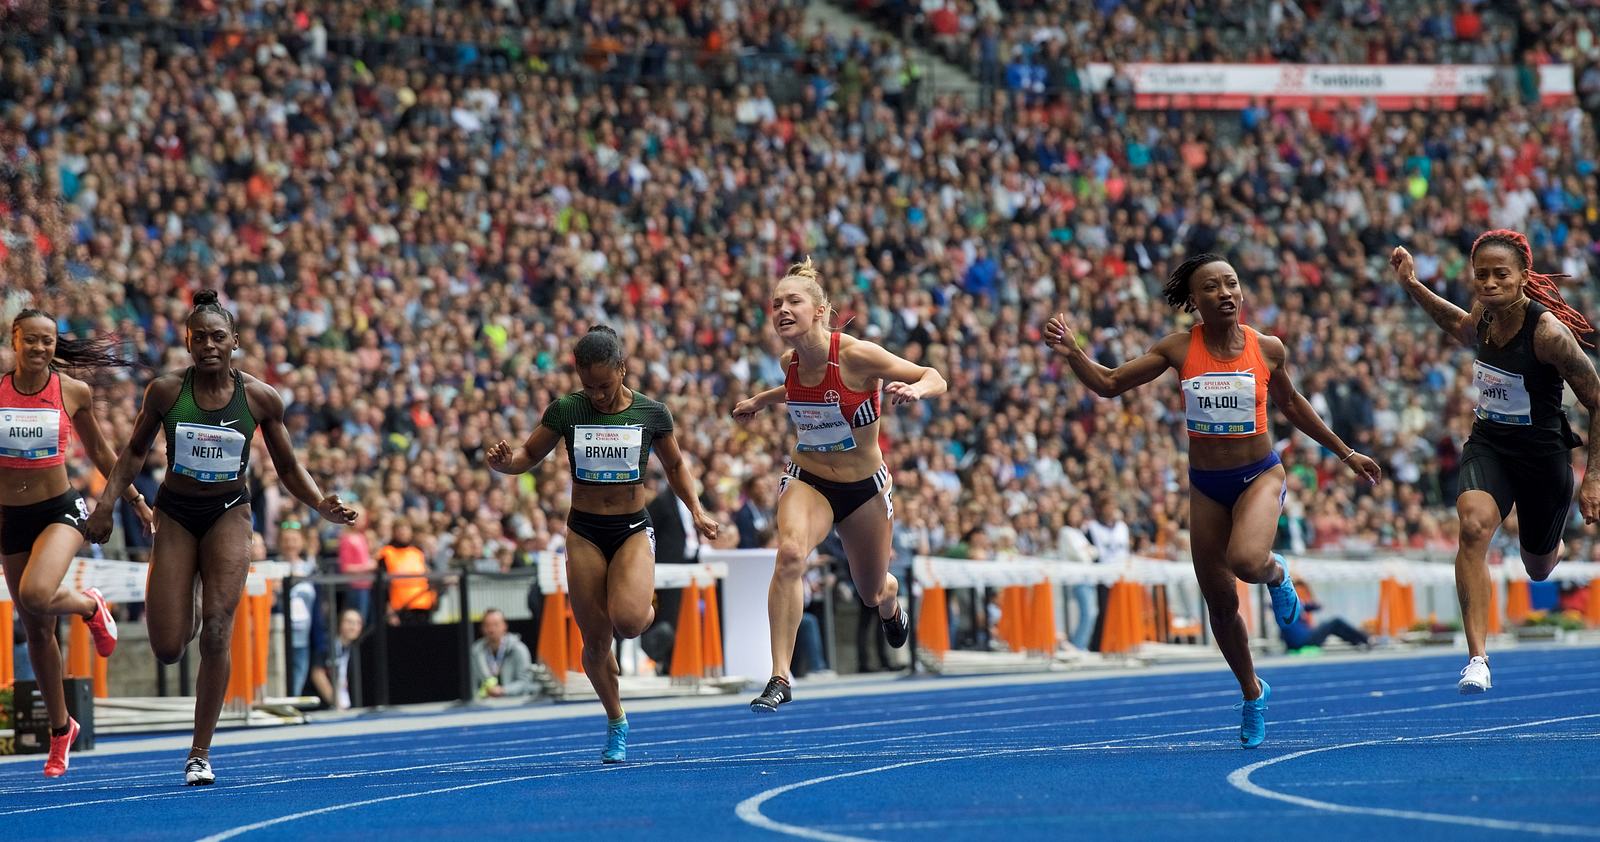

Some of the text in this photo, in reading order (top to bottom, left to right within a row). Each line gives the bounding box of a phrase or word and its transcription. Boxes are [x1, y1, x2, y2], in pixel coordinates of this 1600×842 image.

[1197, 396, 1238, 408] TA LOU
[9, 426, 43, 438] ATCHO
[1228, 424, 1244, 432] 2018
[191, 446, 223, 459] NEITA
[585, 446, 629, 459] BRYANT
